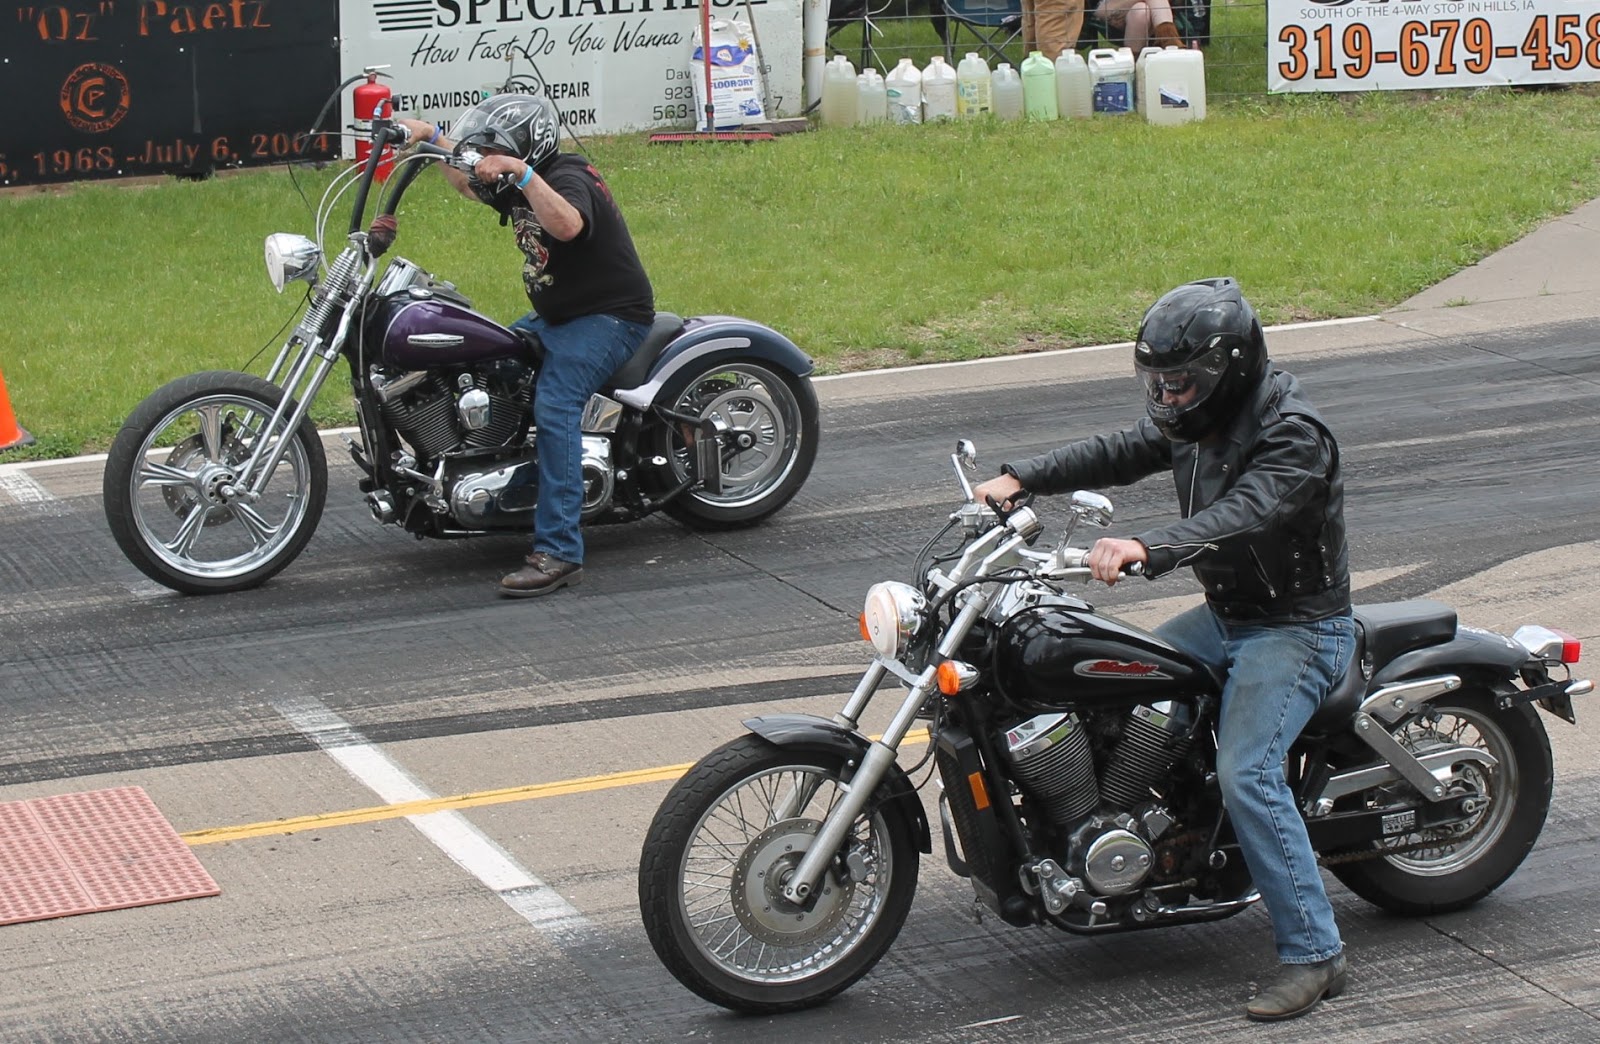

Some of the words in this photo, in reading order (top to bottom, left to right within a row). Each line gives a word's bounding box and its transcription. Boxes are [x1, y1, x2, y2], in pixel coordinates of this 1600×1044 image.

[1300, 8, 1343, 19] SOUTH
[1346, 8, 1363, 18] OF
[1366, 7, 1389, 17] THE
[1392, 5, 1431, 16] 4-WAY
[1434, 3, 1465, 14] STOP
[1468, 3, 1481, 12] IN
[1484, 1, 1520, 12] HILLS,
[1523, 0, 1536, 10] IA
[411, 33, 460, 67] How
[468, 29, 520, 62] Fast
[523, 27, 556, 59] Do
[568, 22, 606, 55] You
[613, 18, 683, 53] Wanna
[423, 90, 480, 110] DAVIDSO
[544, 82, 590, 100] REPAIR
[664, 86, 693, 100] 923
[559, 108, 597, 127] WORK
